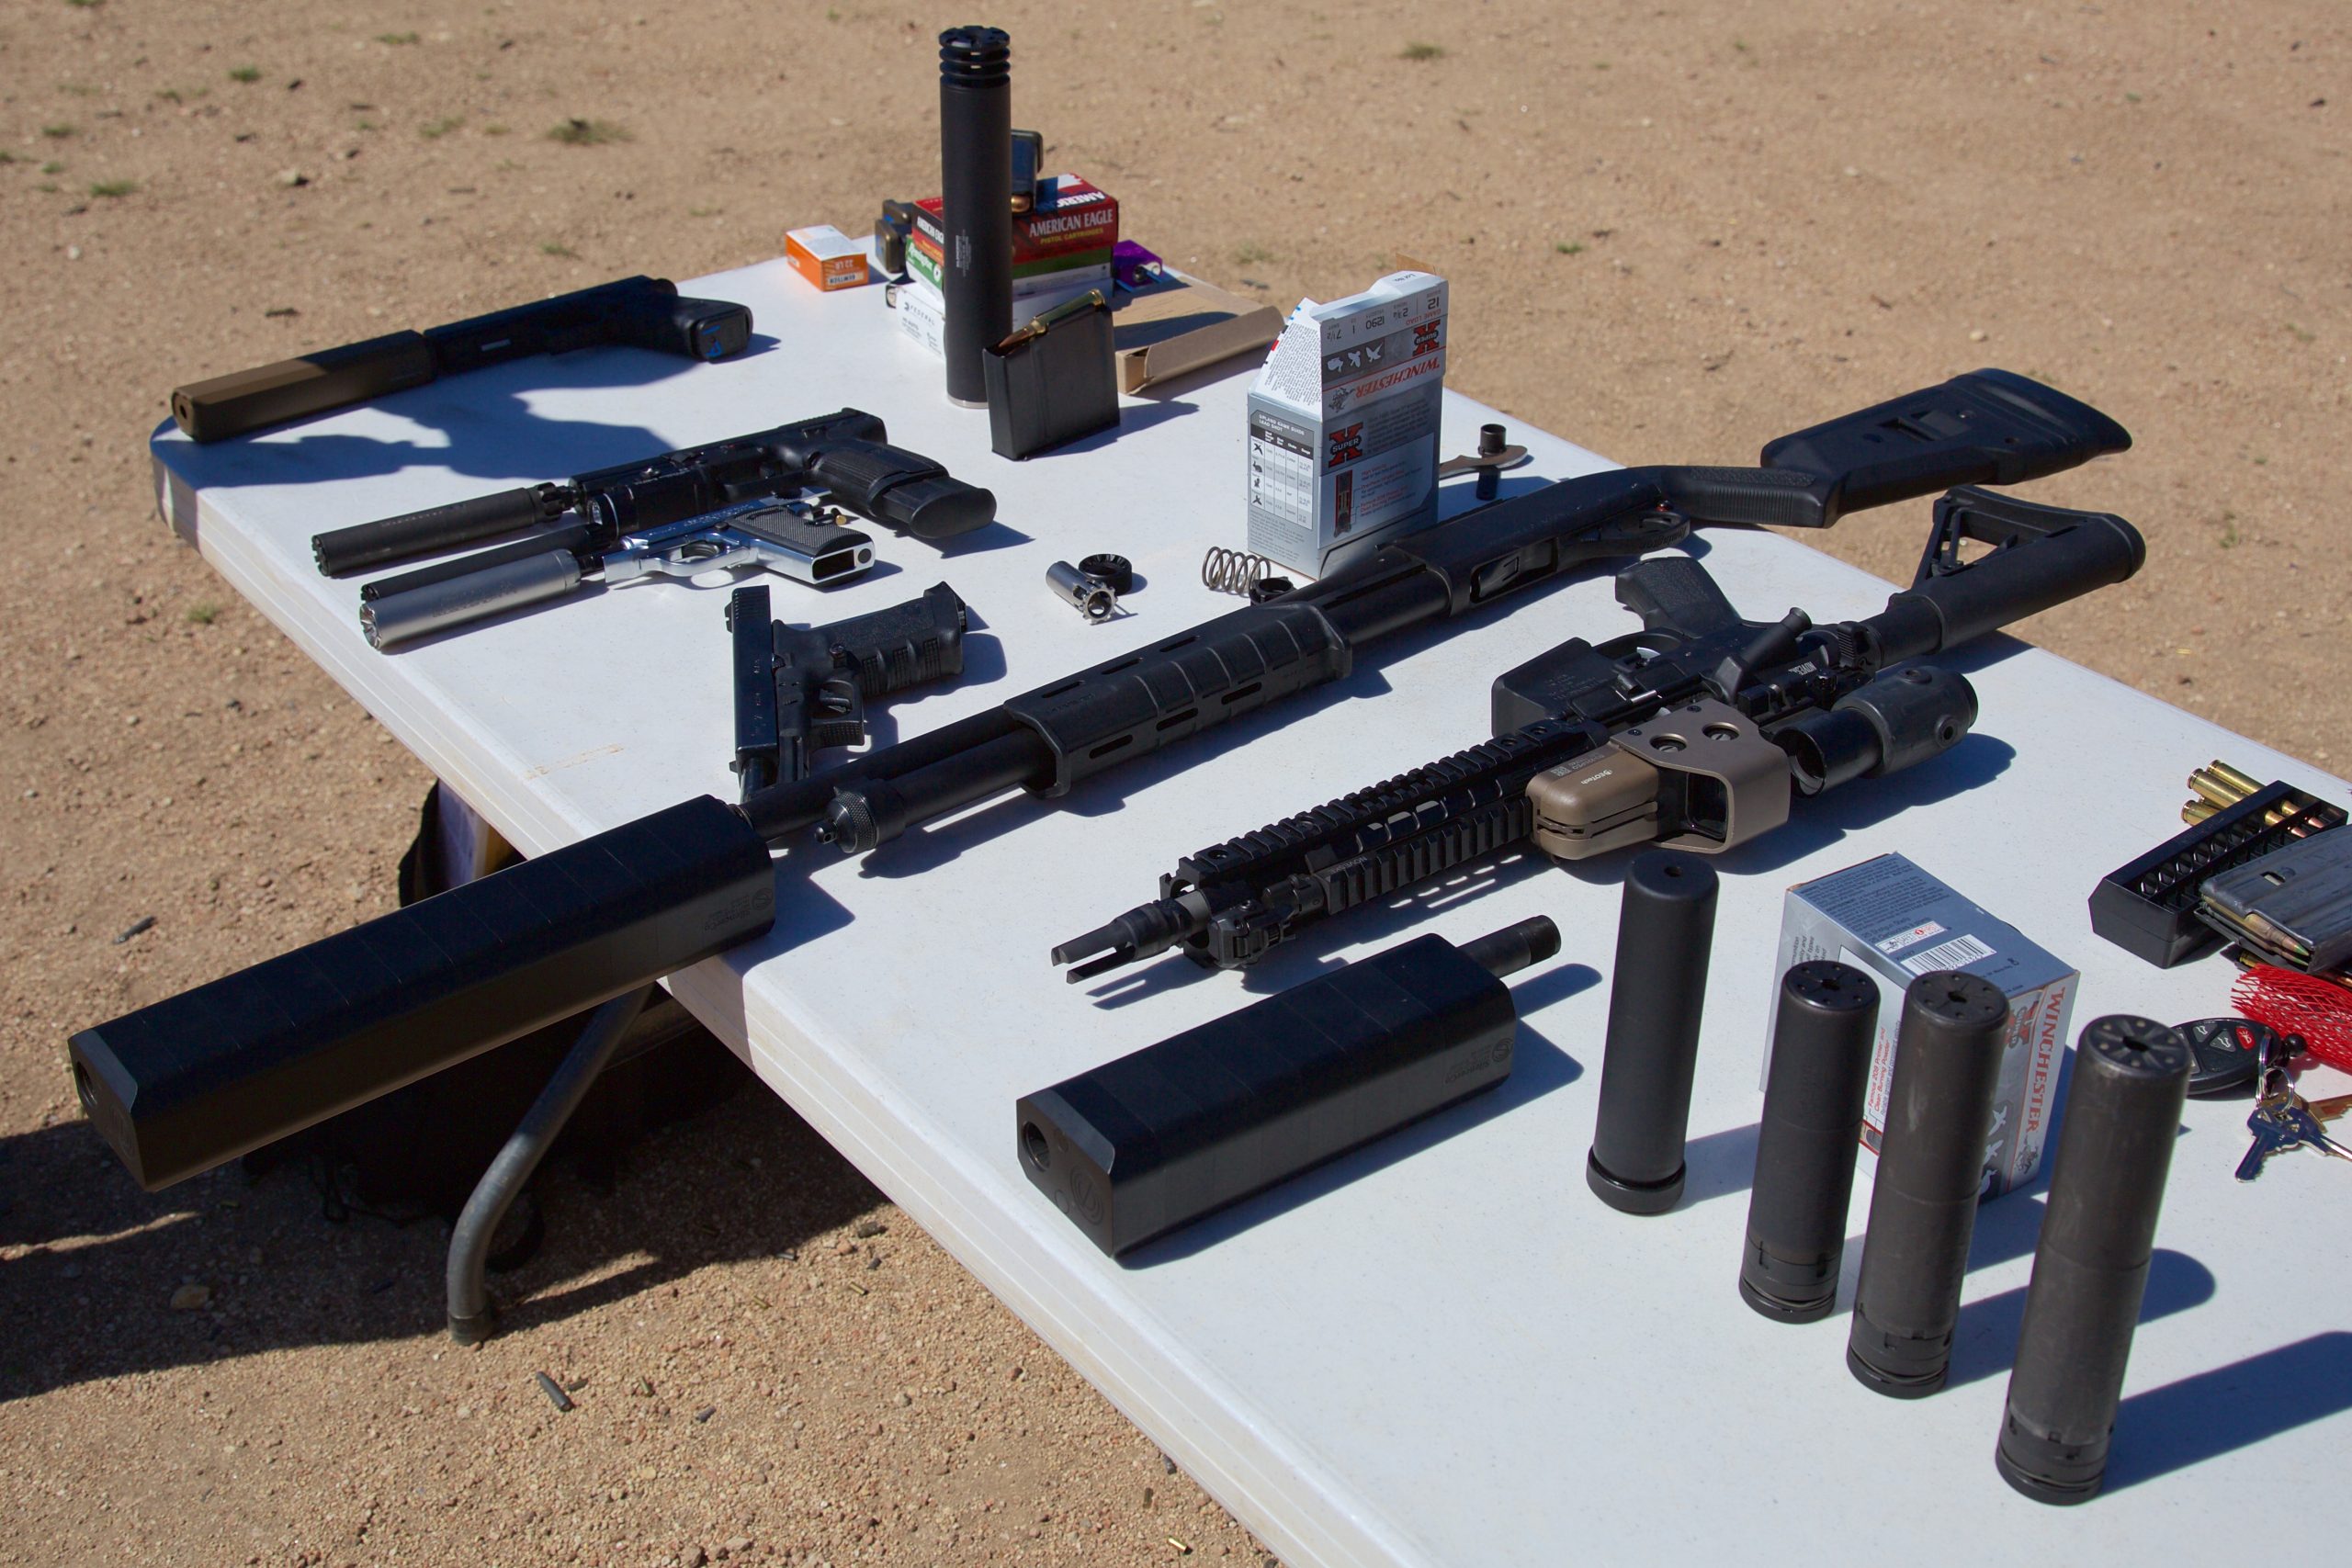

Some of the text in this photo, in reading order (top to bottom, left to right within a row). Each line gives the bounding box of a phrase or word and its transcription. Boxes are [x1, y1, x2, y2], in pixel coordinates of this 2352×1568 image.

[1029, 209, 1114, 238] AMERICAN EAGLE
[1428, 297, 1440, 310] 12
[1365, 316, 1385, 330] 1290
[1355, 356, 1441, 398] WINCHESTER
[1331, 437, 1360, 453] SUPER
[1881, 1040, 1890, 1065] Powder
[2026, 987, 2065, 1133] WINCHESTER
[1877, 1066, 1887, 1091] Burning
[1868, 1083, 1877, 1107] Famous
